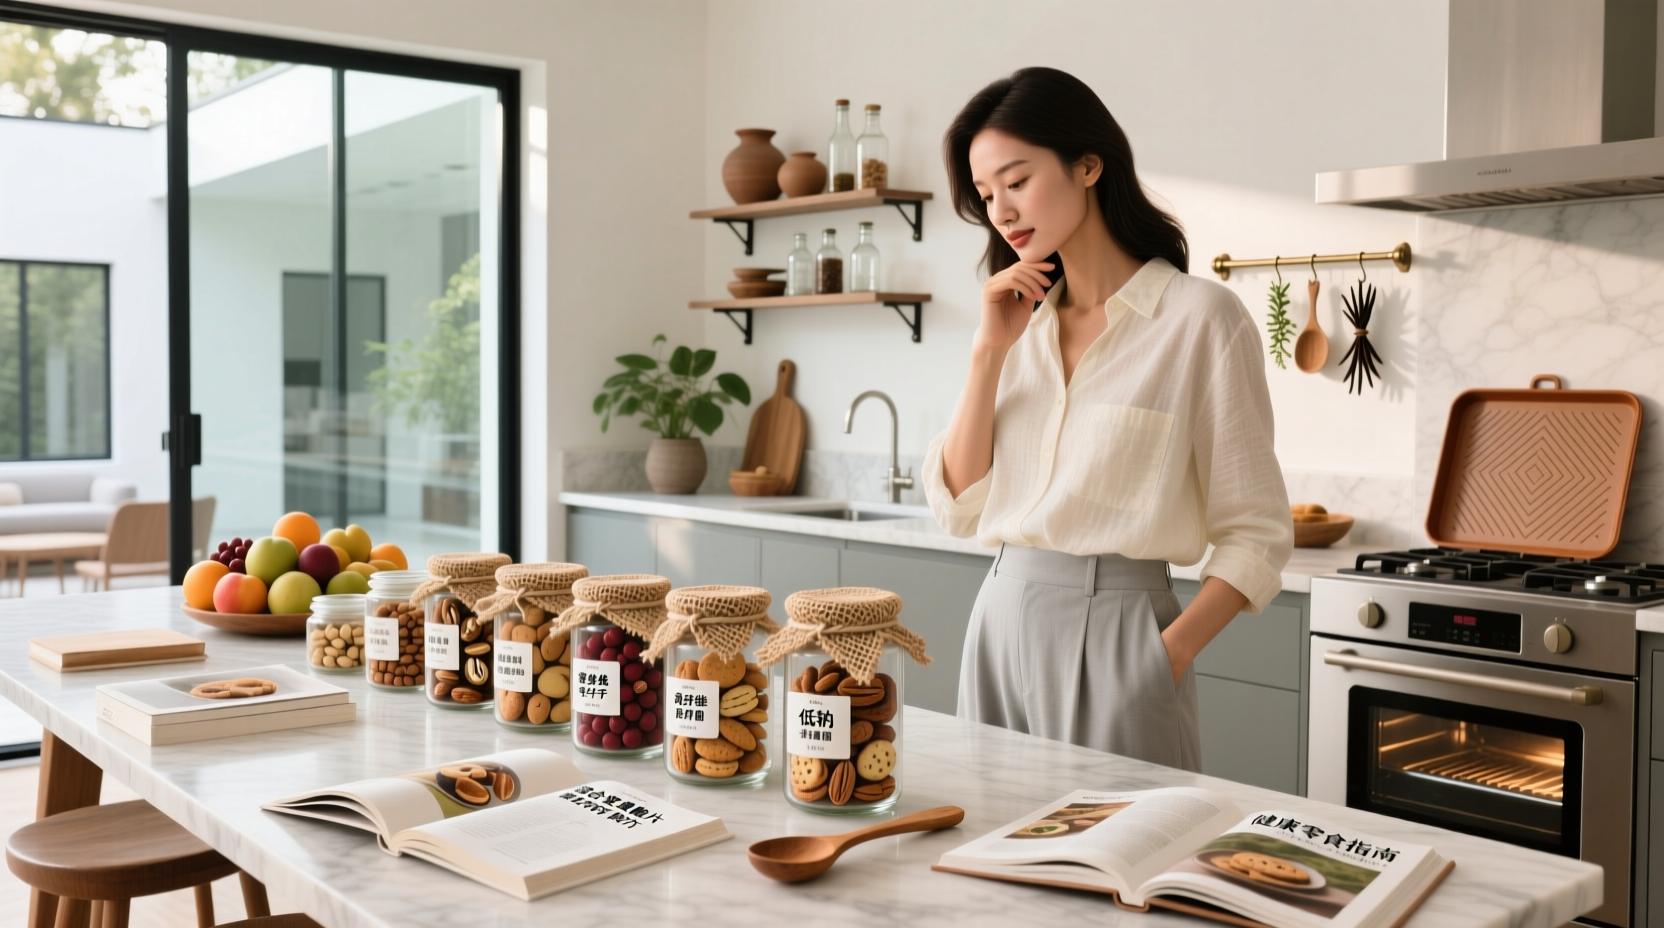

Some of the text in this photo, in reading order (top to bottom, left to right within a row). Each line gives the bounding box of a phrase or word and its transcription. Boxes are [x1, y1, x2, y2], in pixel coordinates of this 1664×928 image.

[798, 708, 834, 728] 低钠
[1251, 814, 1400, 862] 健康零食指南
